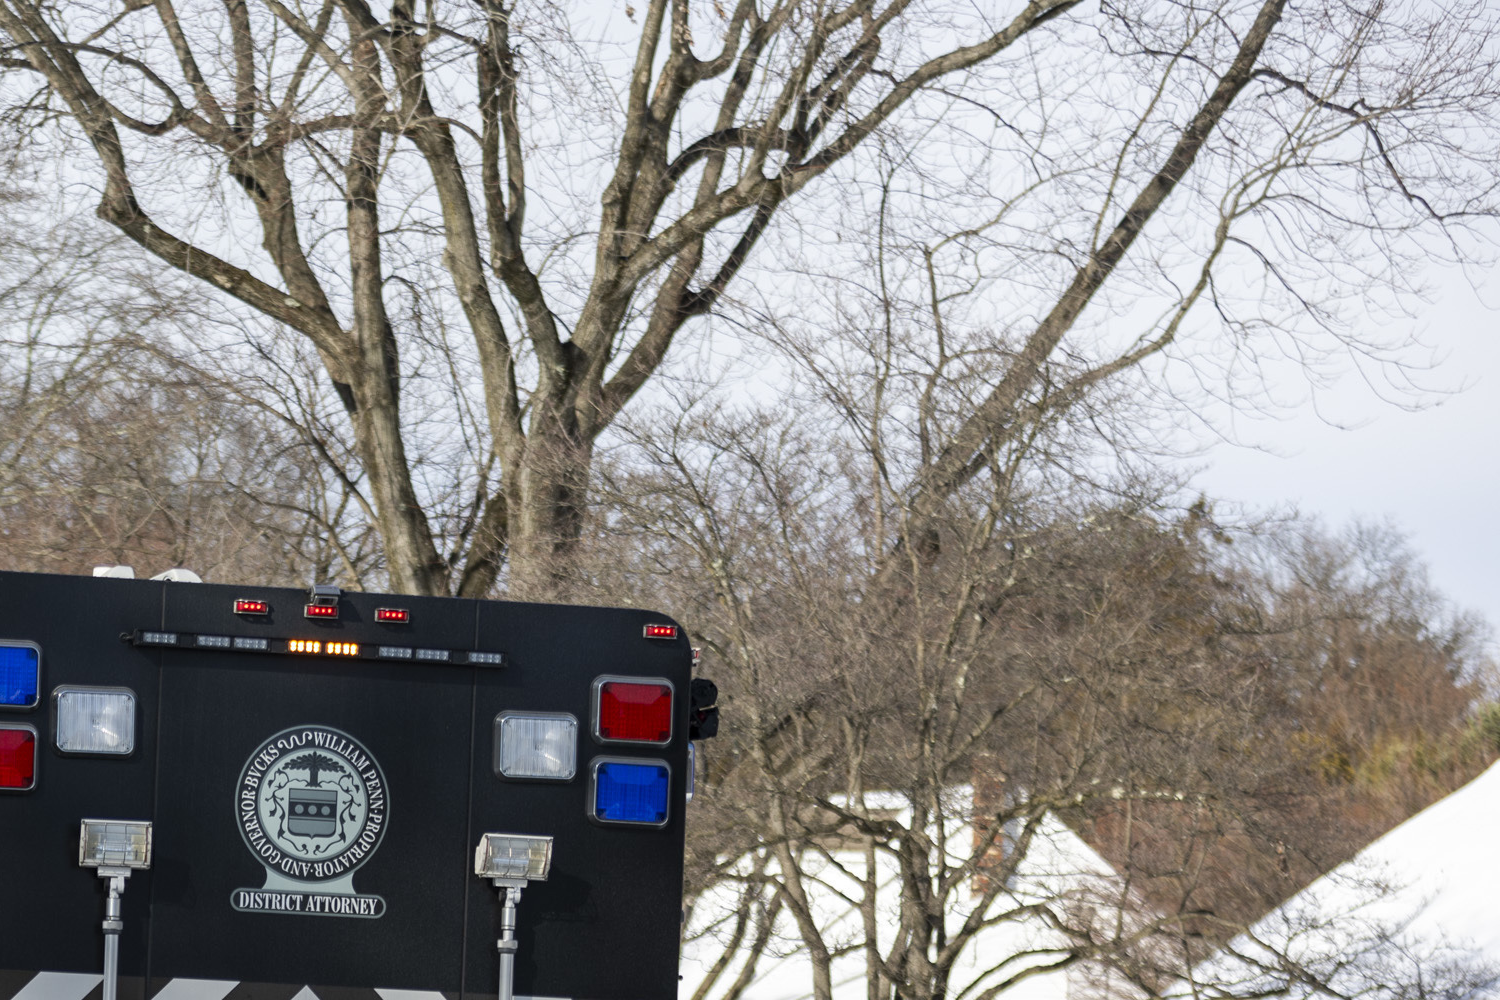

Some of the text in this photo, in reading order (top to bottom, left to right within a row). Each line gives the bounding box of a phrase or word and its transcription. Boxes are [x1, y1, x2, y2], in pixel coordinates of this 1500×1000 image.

[313, 731, 369, 773] WILLIAM
[362, 770, 383, 811] PENN
[240, 790, 280, 864] GOVERNOR
[314, 813, 383, 878] PROPRIATOR
[280, 859, 311, 877] AND
[239, 891, 377, 915] DISTRICT ATTORNEY
